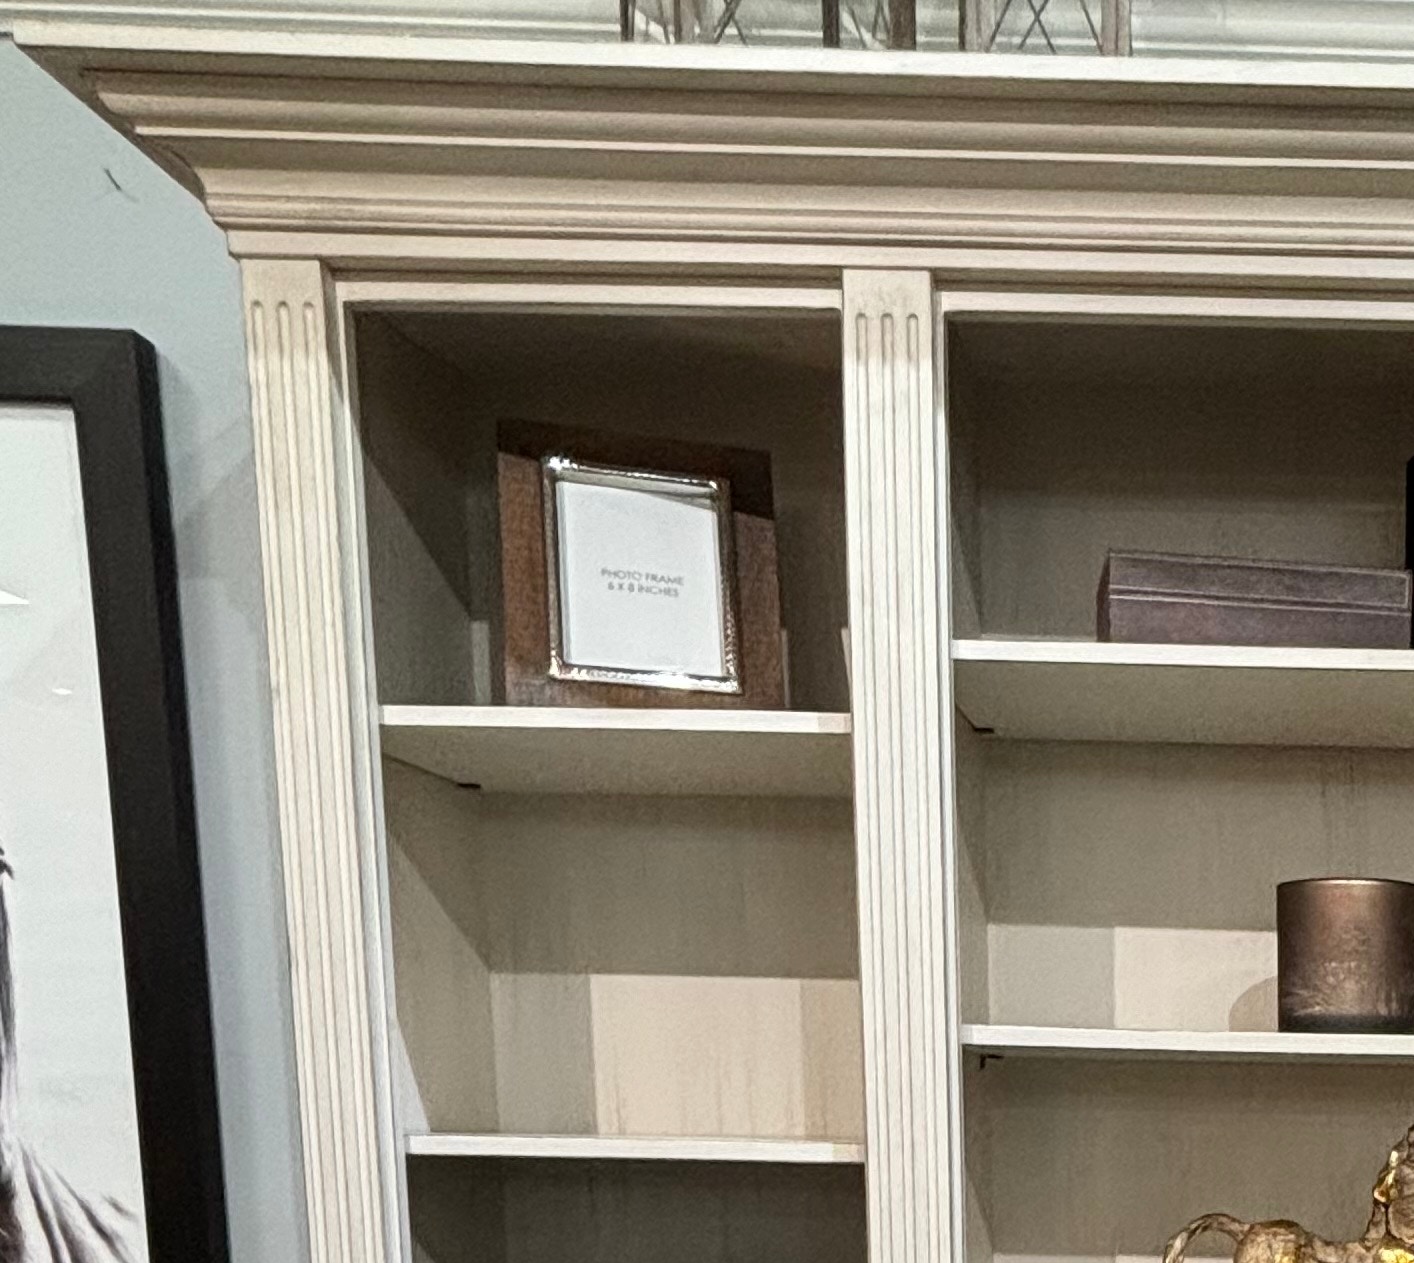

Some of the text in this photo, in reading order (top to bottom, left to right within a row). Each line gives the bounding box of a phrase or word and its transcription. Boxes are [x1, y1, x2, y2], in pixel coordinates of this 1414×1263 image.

[600, 567, 684, 586] PHOTO FRAME
[607, 581, 615, 591] 6
[637, 583, 679, 598] INCHES
